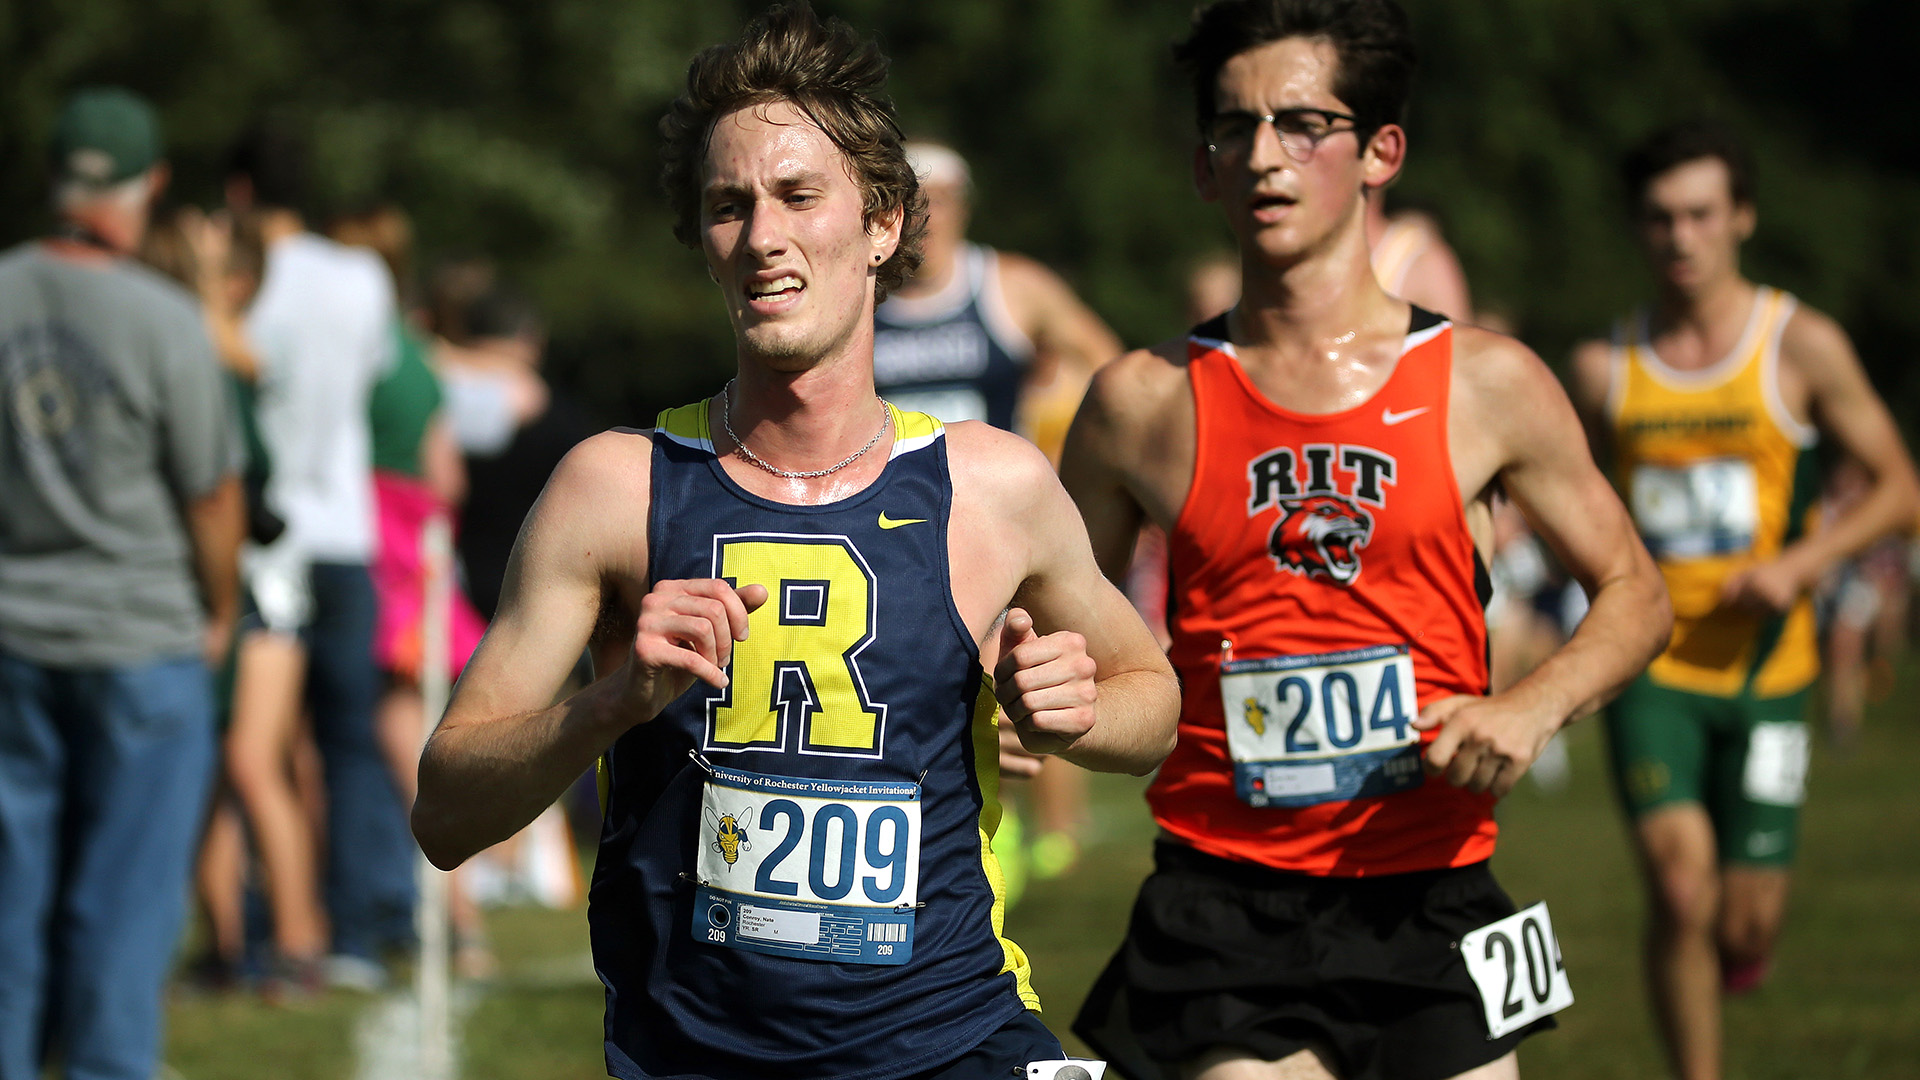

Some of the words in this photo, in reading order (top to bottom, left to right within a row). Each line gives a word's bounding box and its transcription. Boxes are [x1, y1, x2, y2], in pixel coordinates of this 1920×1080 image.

[1246, 443, 1397, 518] RIT
[703, 532, 887, 759] R
[1276, 664, 1409, 753] 204
[753, 777, 764, 786] of
[764, 778, 809, 791] Rochester
[811, 782, 867, 795] Yellowjacket
[755, 798, 909, 903] 209
[708, 928, 725, 943] 209
[877, 944, 893, 956] 209
[1485, 917, 1563, 1020] 20
